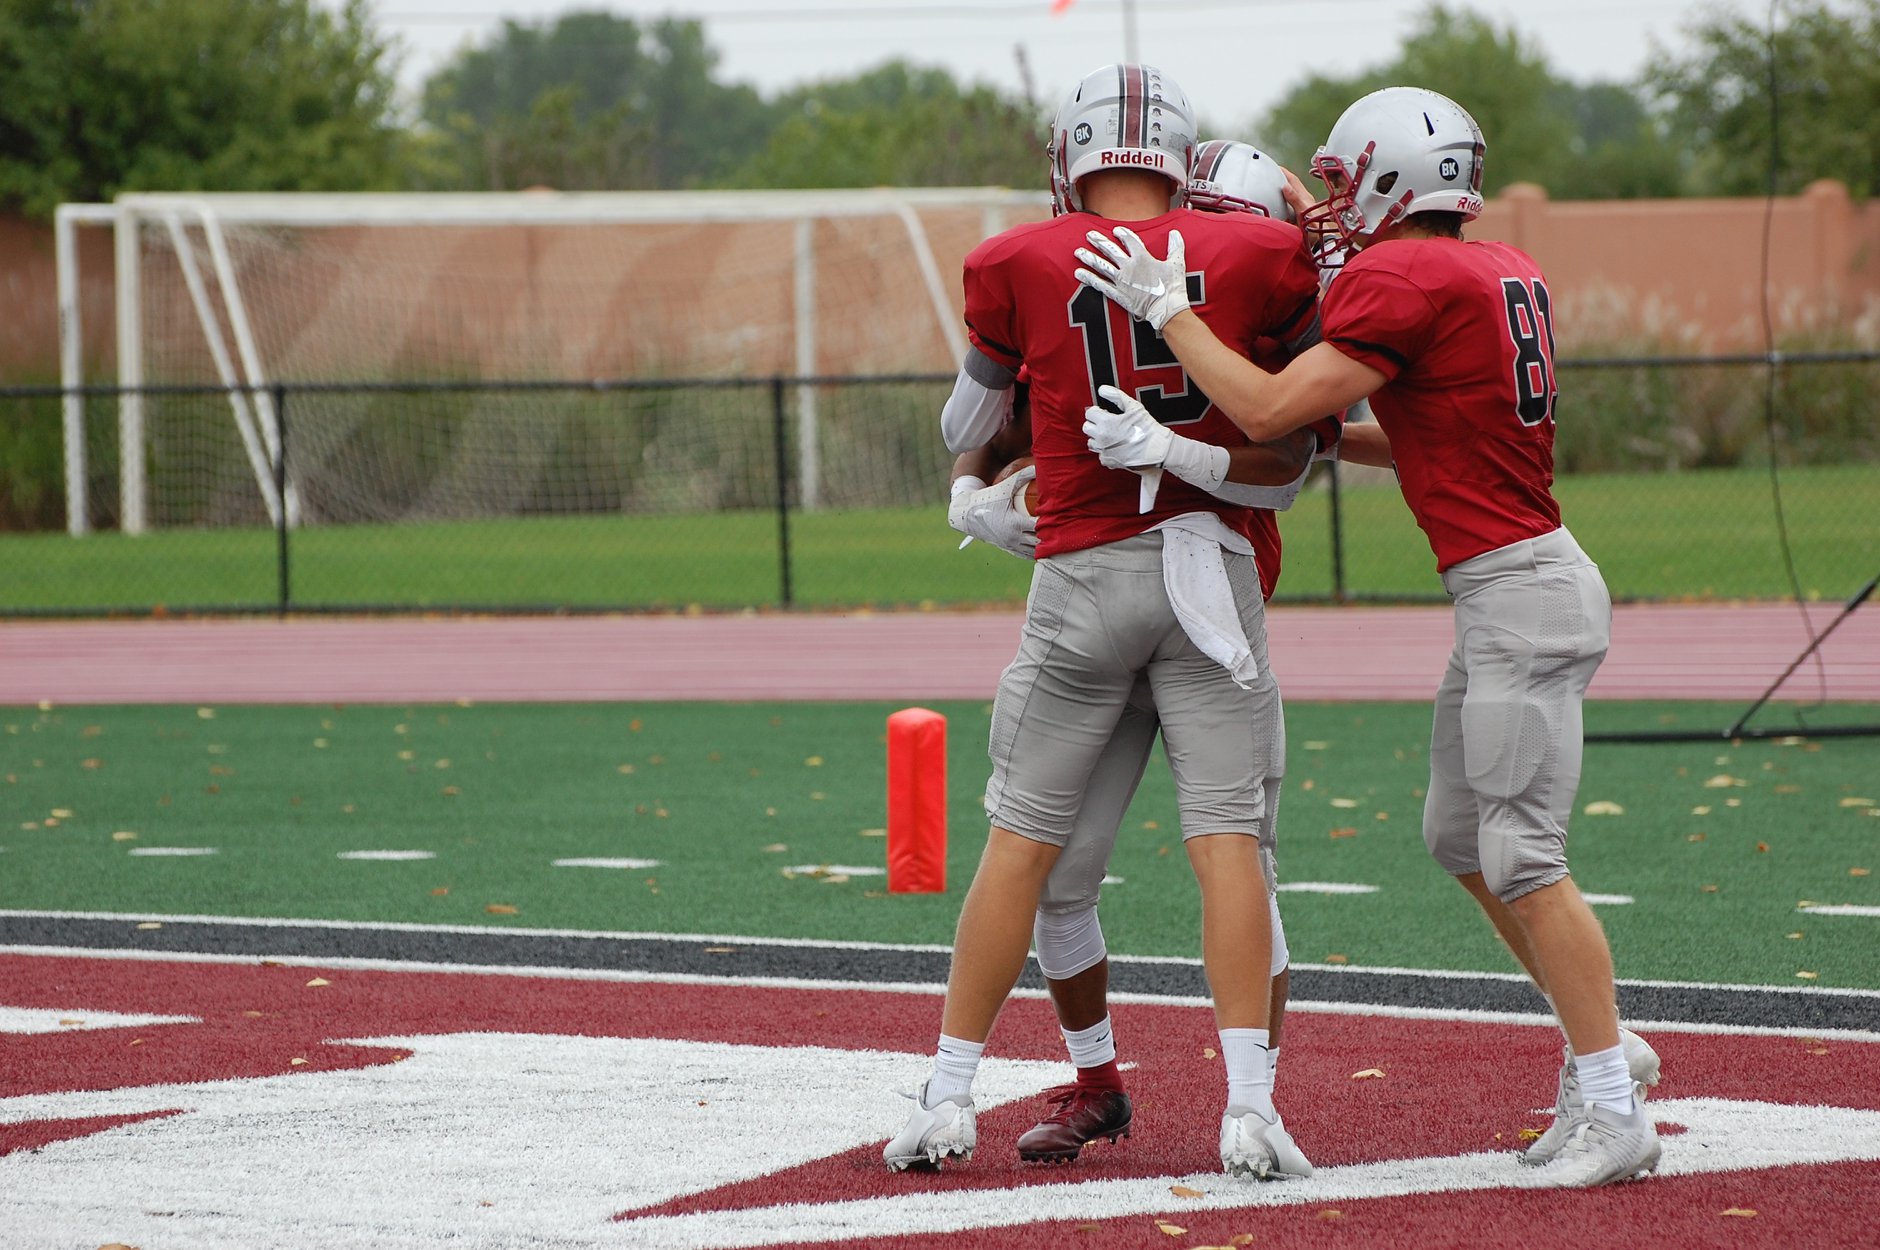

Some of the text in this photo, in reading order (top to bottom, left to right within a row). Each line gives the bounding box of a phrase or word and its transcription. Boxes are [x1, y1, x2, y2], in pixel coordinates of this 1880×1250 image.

[1075, 125, 1090, 142] BK
[1101, 151, 1164, 168] Riddell
[1441, 161, 1457, 177] BK
[1067, 271, 1212, 426] 15
